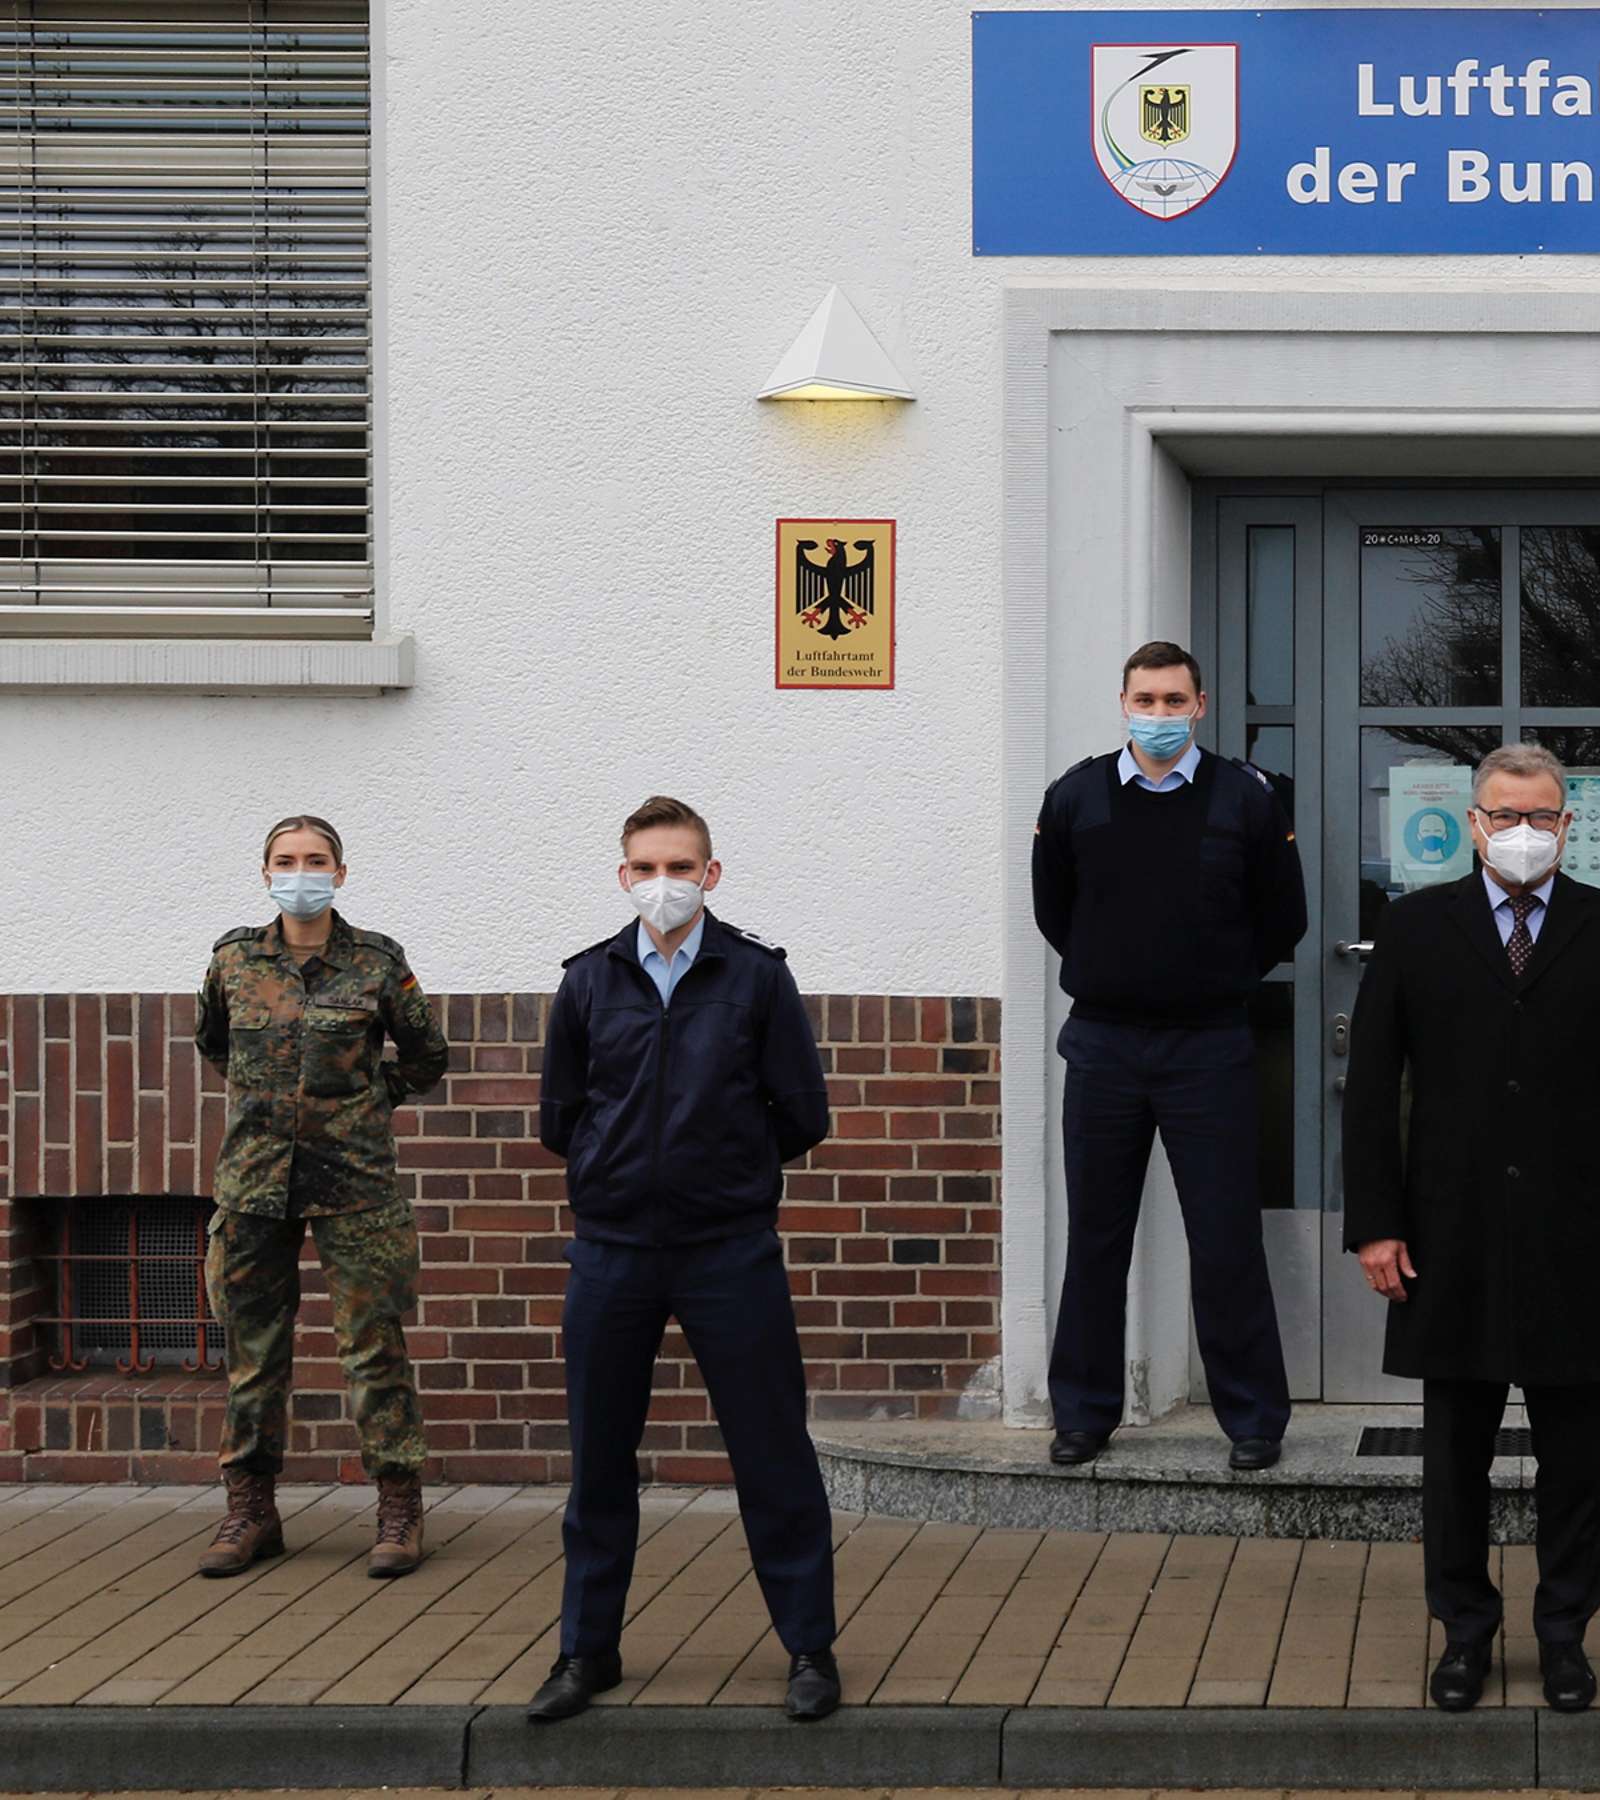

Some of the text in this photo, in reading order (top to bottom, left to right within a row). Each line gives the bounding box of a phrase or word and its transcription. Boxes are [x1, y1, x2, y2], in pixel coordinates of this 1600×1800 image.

[1286, 147, 1416, 204] der
[796, 650, 875, 661] Luftfahrtamt
[787, 666, 883, 678] der Bundeswehr
